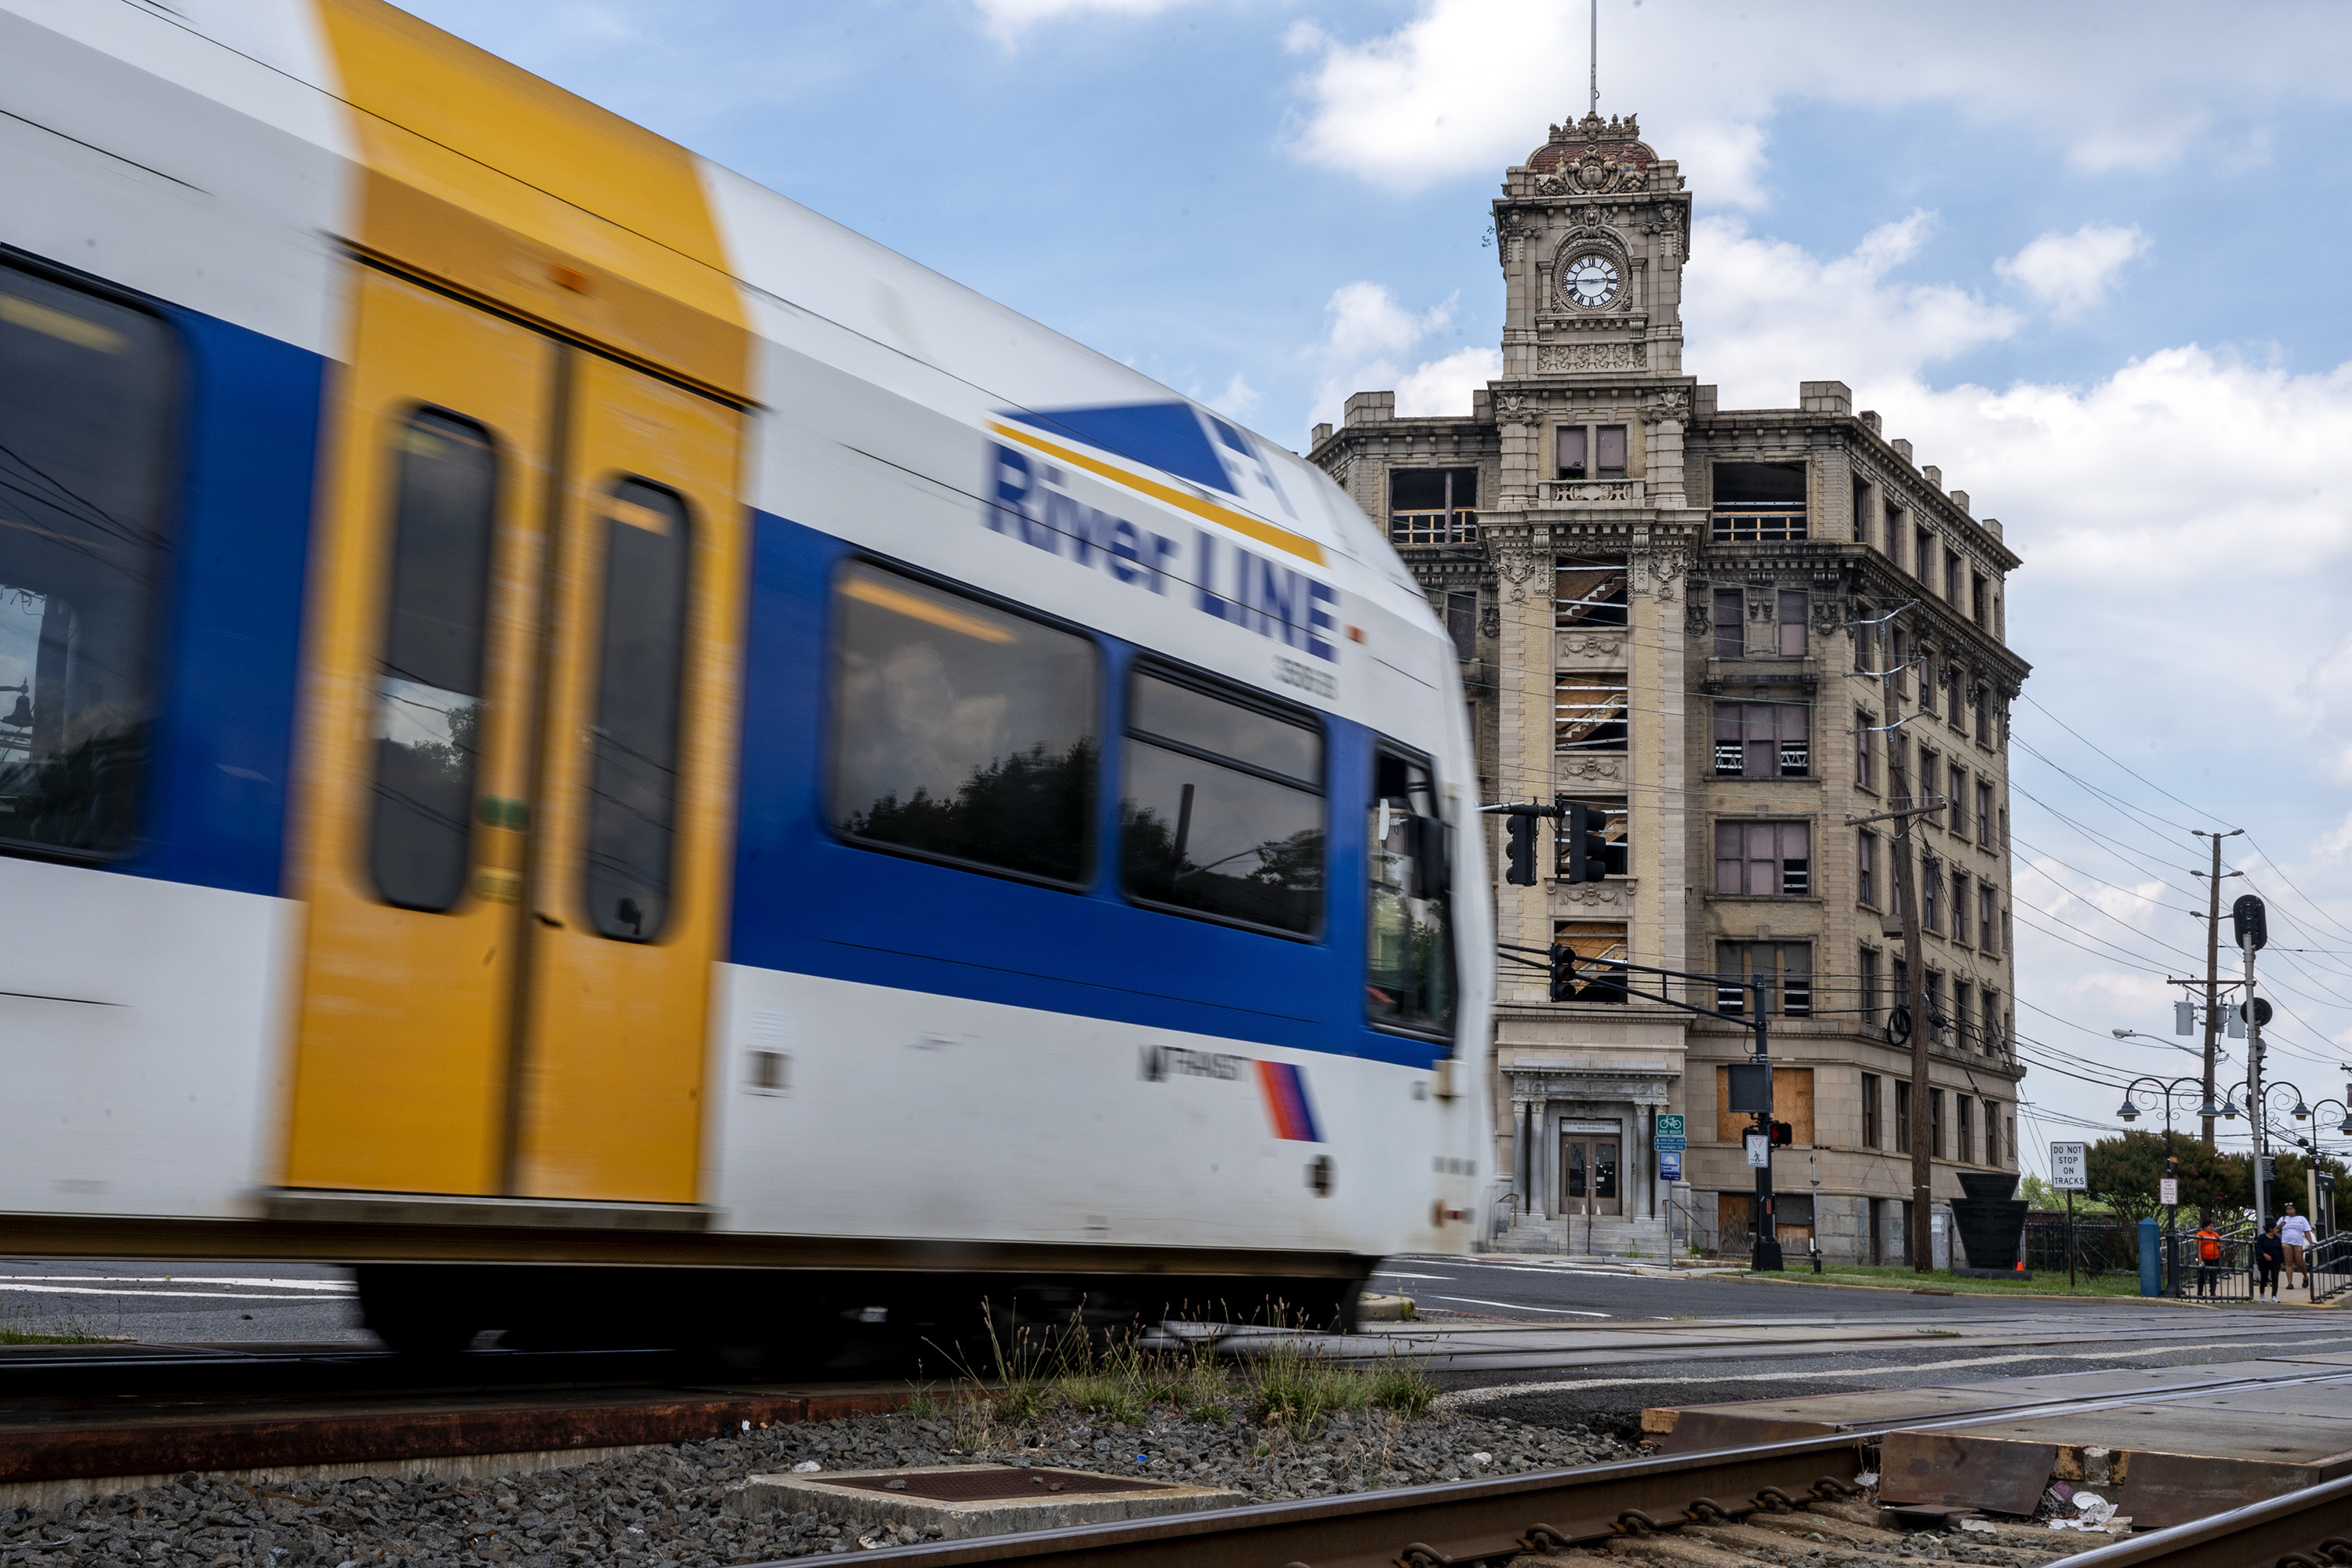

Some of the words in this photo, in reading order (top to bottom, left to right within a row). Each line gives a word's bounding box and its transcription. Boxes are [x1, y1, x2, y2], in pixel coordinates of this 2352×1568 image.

[981, 437, 1181, 598] River
[1190, 528, 1341, 665] LINE
[2054, 1177, 2085, 1185] TRACKS
